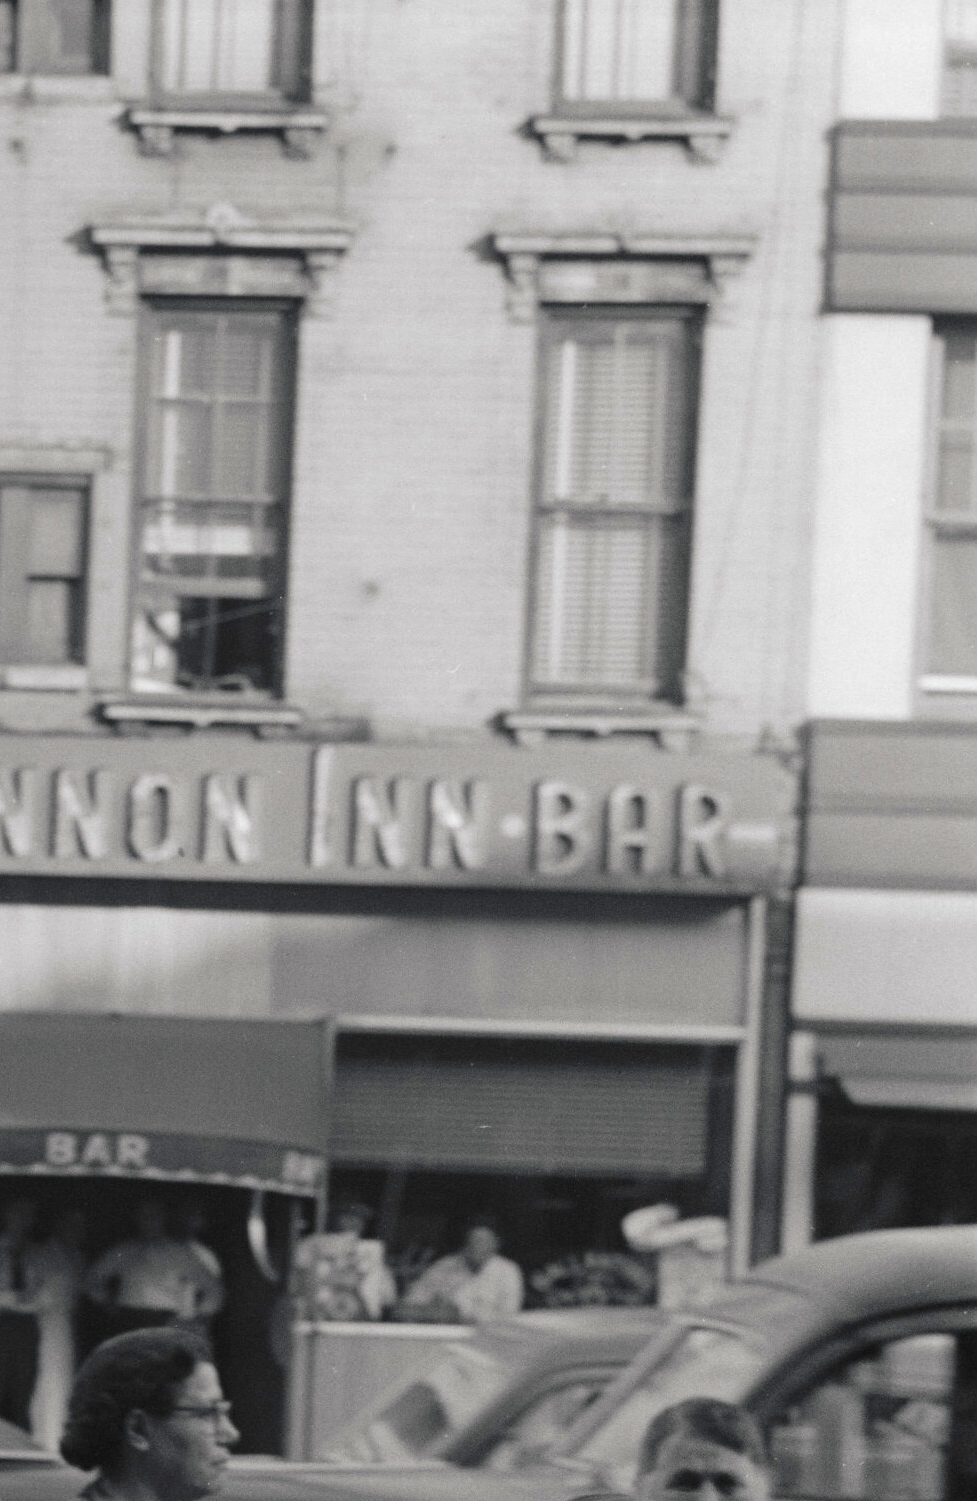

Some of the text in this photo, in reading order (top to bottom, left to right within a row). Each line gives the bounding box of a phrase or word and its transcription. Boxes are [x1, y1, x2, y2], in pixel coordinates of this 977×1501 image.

[309, 744, 487, 872] INN
[529, 778, 723, 879] BAR
[45, 1131, 151, 1168] BAR
